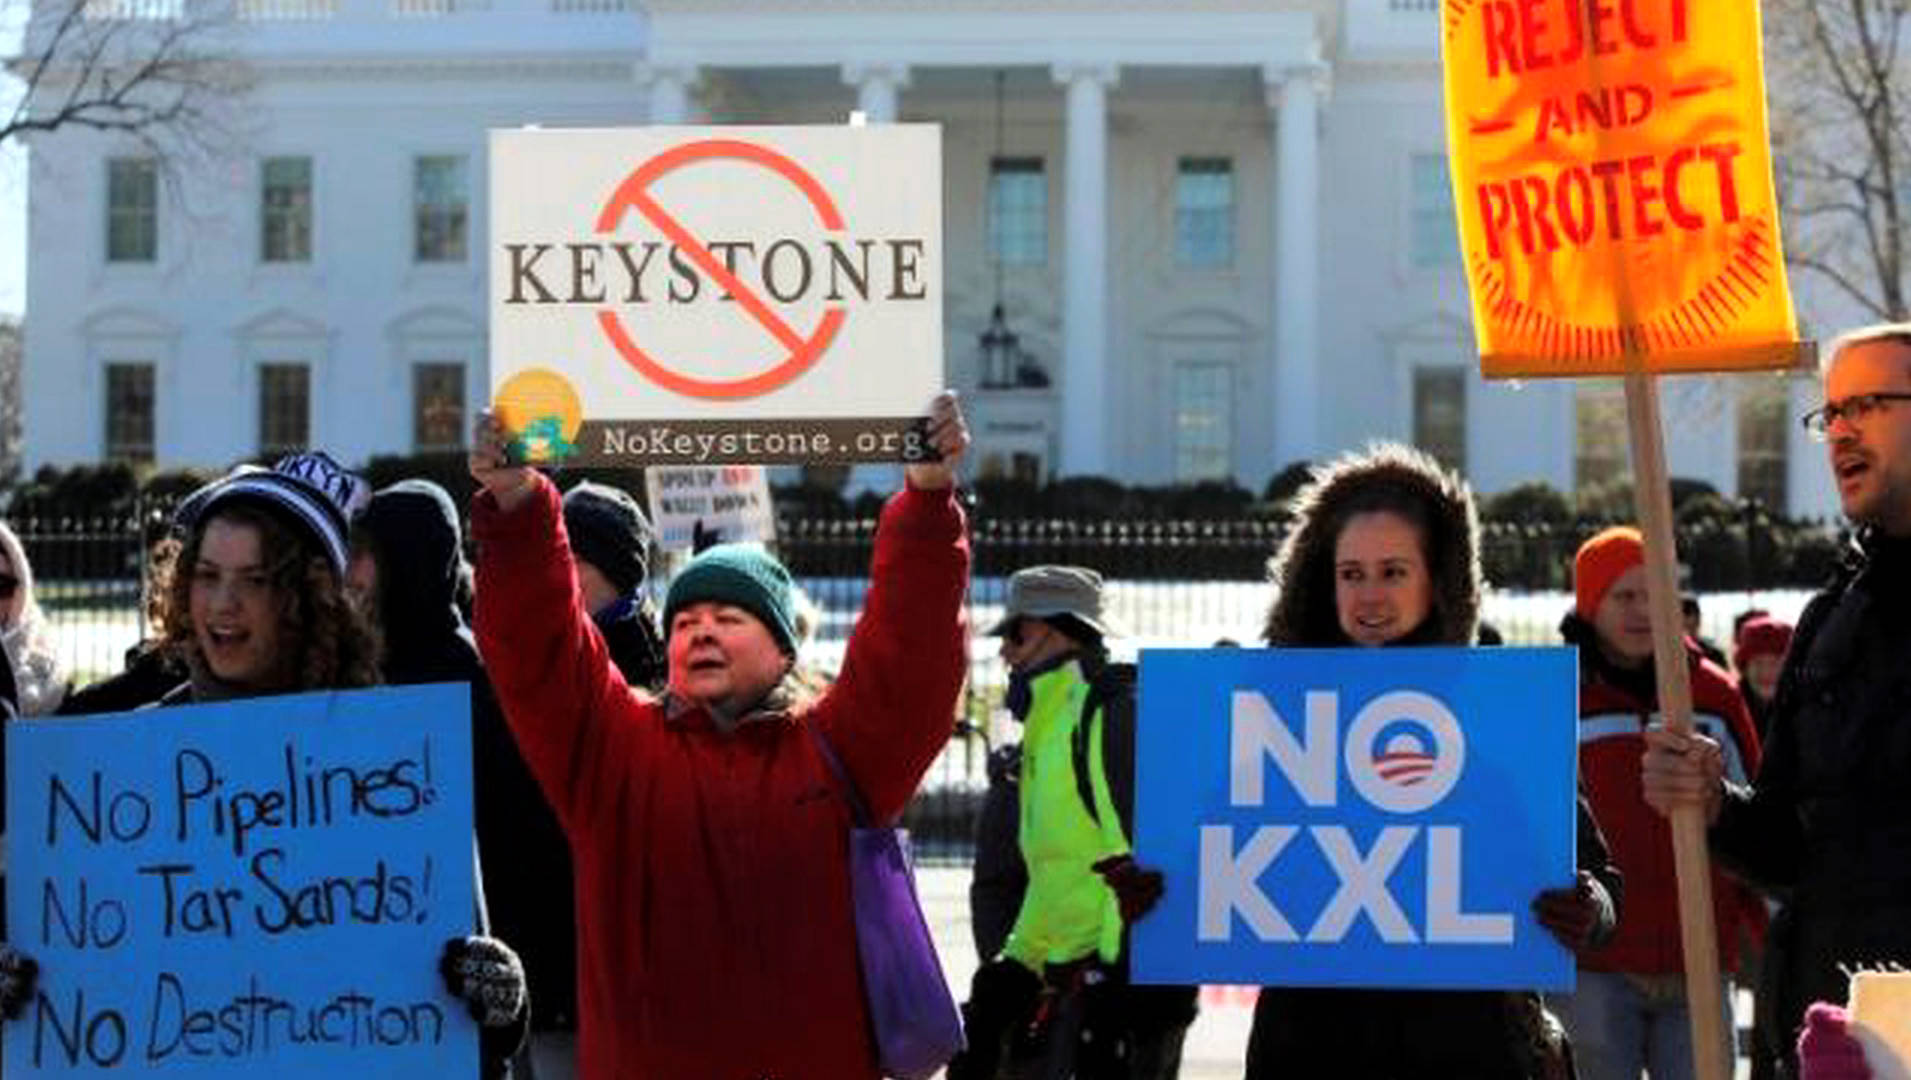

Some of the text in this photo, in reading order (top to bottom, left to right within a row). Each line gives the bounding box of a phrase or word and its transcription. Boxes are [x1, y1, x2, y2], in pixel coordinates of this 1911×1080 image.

[1534, 83, 1654, 144] AND
[1478, 141, 1744, 261] PROTECT
[504, 239, 928, 304] KEYSTONE
[602, 427, 922, 460] NoKeystone.org
[46, 736, 438, 857] No Pipelines!
[1229, 689, 1466, 814] NO
[41, 847, 434, 951] No Tar Sands!
[1197, 825, 1515, 944] KXL
[32, 971, 445, 1069] No Destruction
